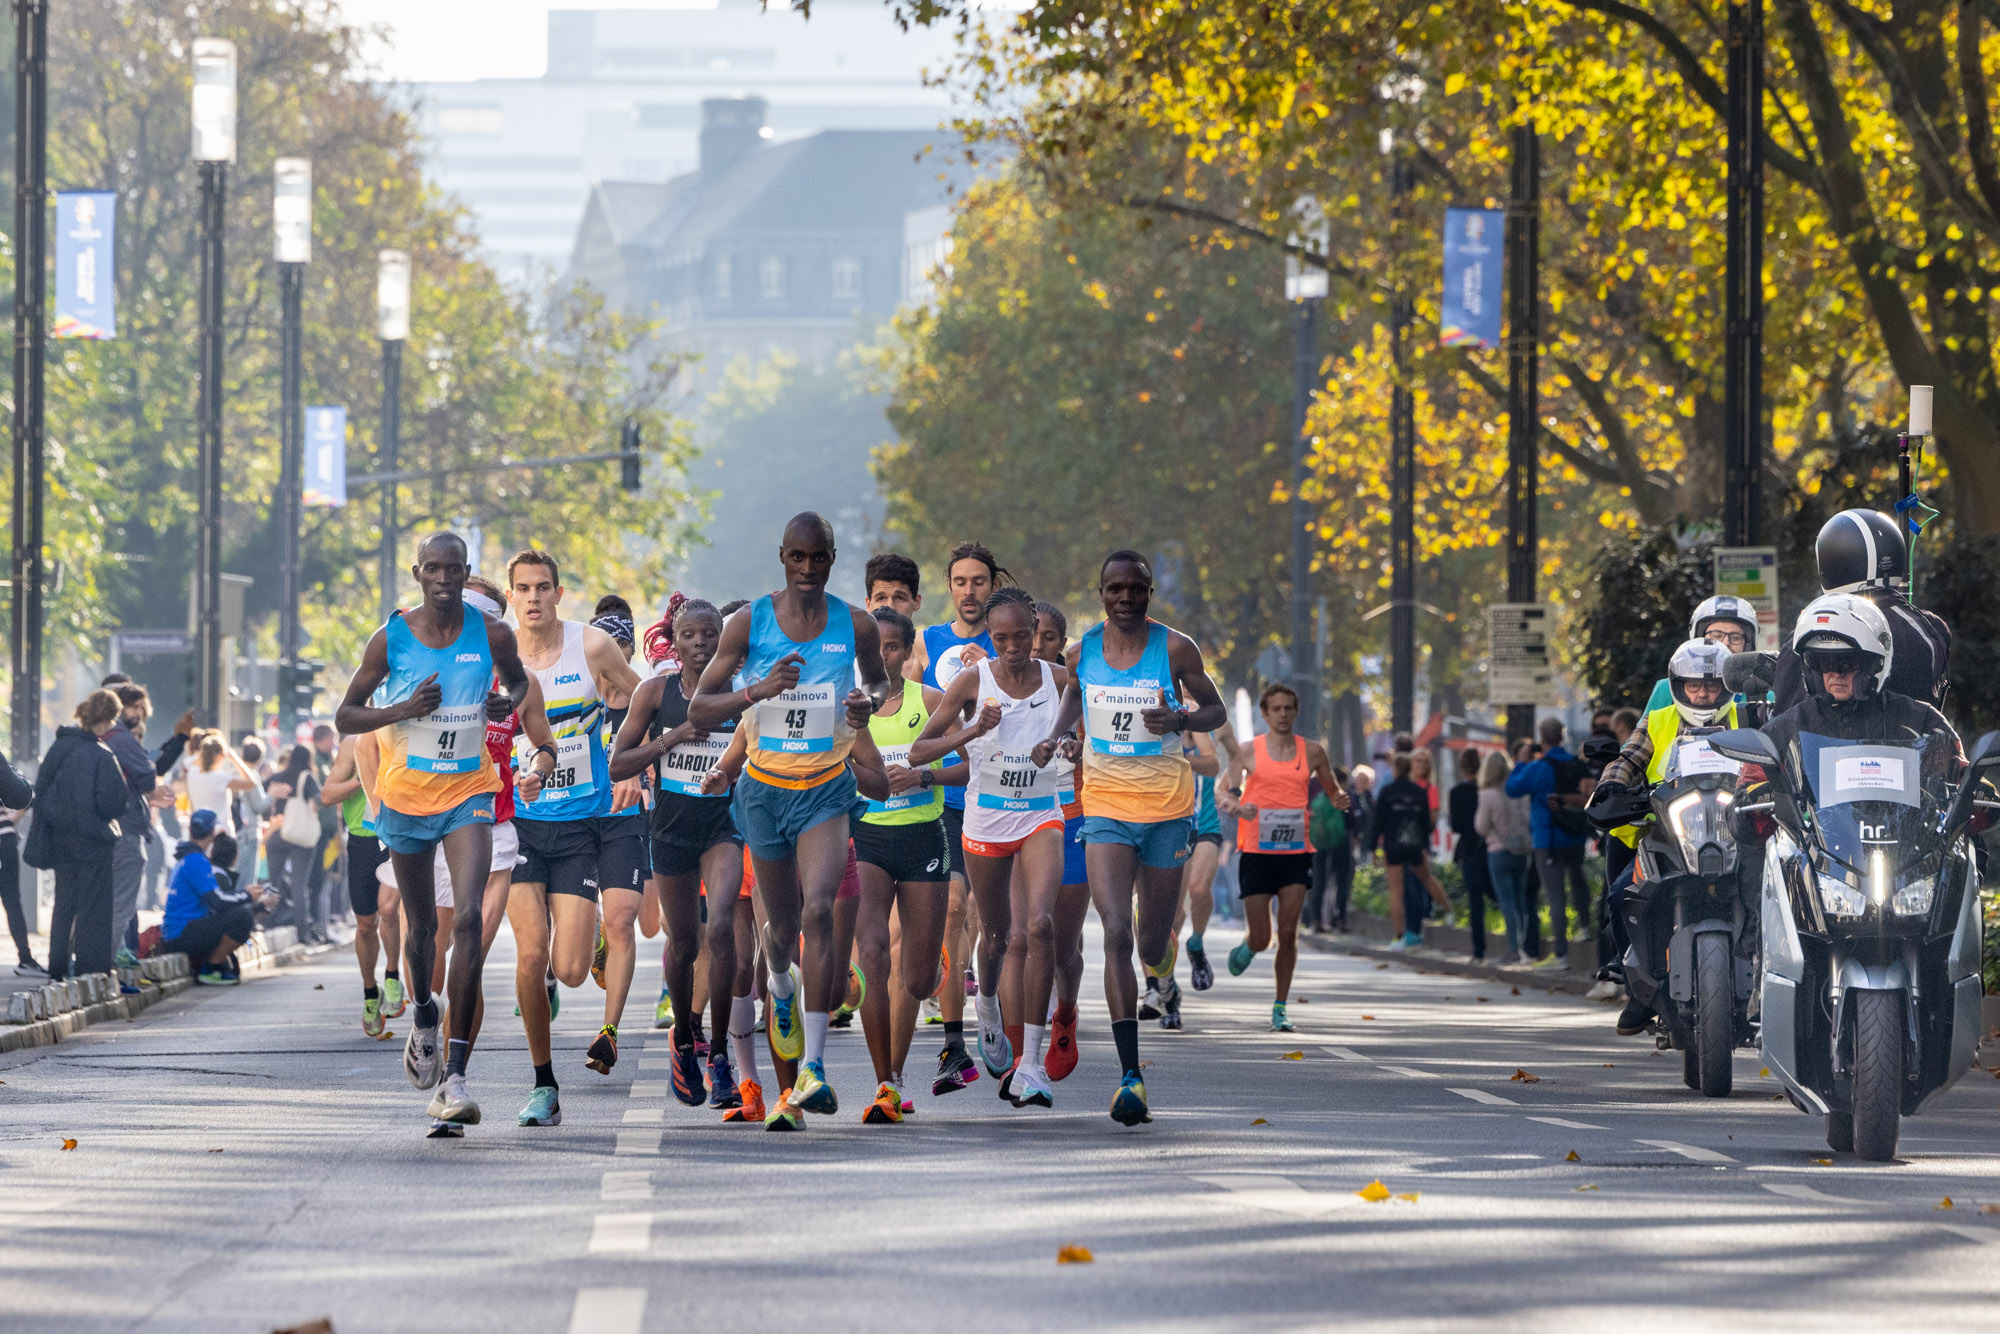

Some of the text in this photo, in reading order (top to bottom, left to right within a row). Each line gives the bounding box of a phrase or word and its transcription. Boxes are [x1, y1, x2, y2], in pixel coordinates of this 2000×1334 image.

[822, 644, 847, 653] HOKA
[455, 653, 481, 662] HOKA
[554, 673, 581, 686] HOKA
[1132, 679, 1160, 688] HOKA
[779, 691, 828, 701] mainova
[1106, 694, 1156, 705] mainova
[431, 712, 478, 723] mainova
[785, 709, 807, 729] 43
[1111, 712, 1133, 732] 42
[438, 730, 457, 750] 41
[788, 731, 804, 739] PACE
[1113, 733, 1130, 742] PACE
[558, 743, 583, 754] nova
[782, 741, 809, 751] HOKA
[1109, 744, 1135, 754] HOKA
[438, 751, 454, 760] PACE
[882, 751, 909, 762] aino
[1003, 754, 1031, 764] main
[431, 762, 459, 771] HOKA
[546, 767, 576, 789] 358
[691, 774, 705, 783] F12
[1000, 769, 1037, 788] SELLY
[683, 784, 702, 794] HOK
[545, 789, 571, 800] HOKA
[1014, 790, 1022, 799] F2
[884, 798, 910, 809] HOKA
[1003, 800, 1030, 809] HOKA
[1271, 829, 1296, 842] 6727
[967, 841, 987, 853] EOS
[583, 878, 598, 889] HOK
